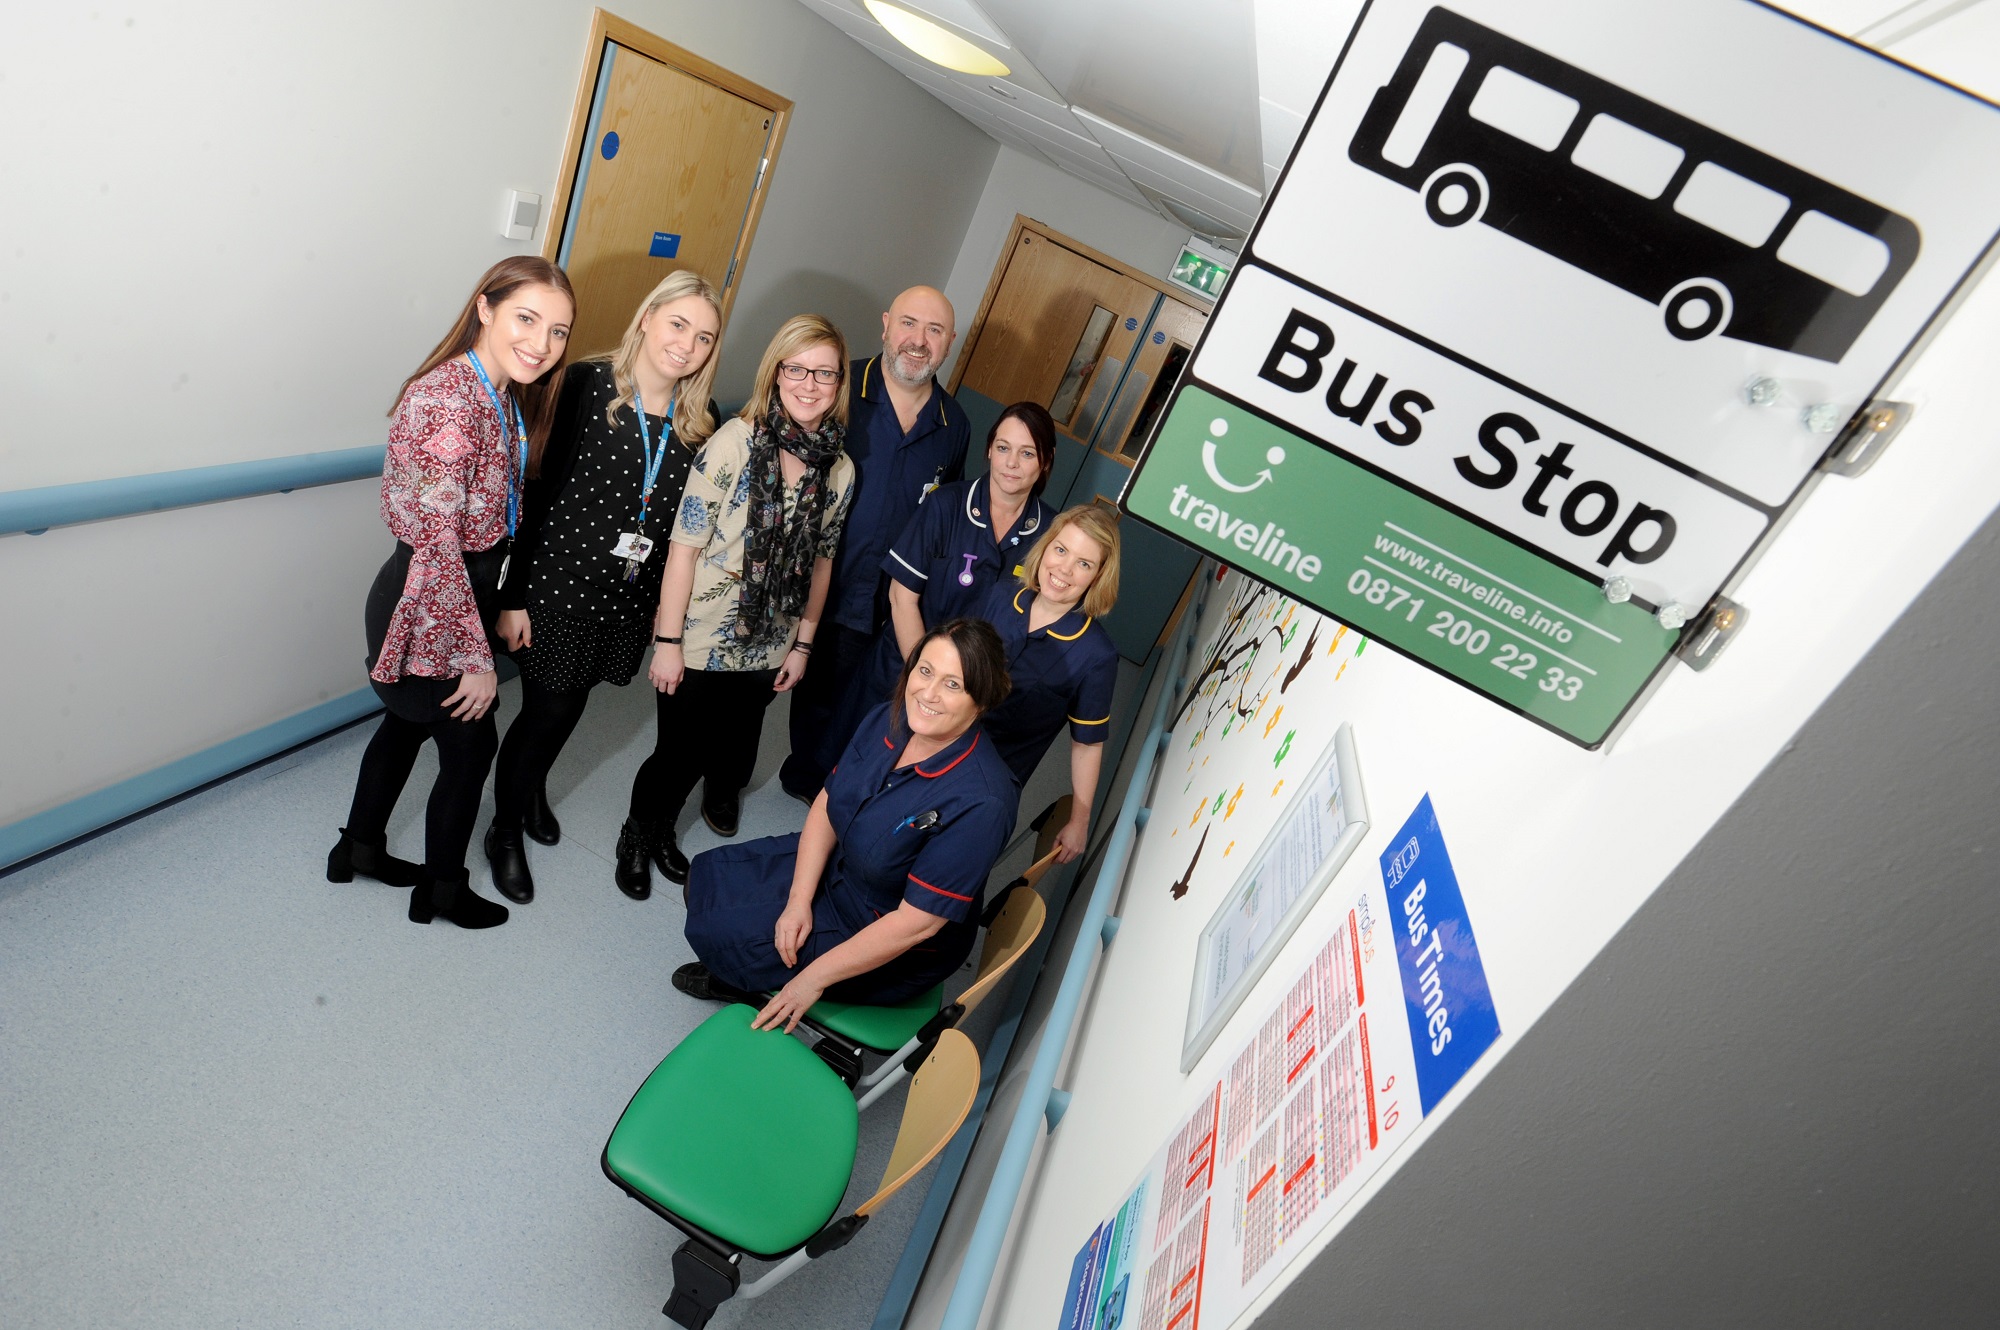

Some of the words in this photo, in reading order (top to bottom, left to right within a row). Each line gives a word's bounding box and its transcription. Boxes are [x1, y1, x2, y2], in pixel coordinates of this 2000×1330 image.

[1257, 307, 1435, 447] Bus
[1453, 412, 1677, 568] Stop
[1168, 484, 1322, 582] traveline
[1347, 569, 1425, 622] 0871
[1427, 610, 1491, 655] 200
[1490, 643, 1538, 680] 22
[1538, 666, 1584, 702] 33
[1374, 534, 1573, 644] www.traveline.info
[1403, 878, 1428, 947] Bus
[1416, 928, 1452, 1056] Times
[1381, 1075, 1395, 1092] 9
[1383, 1100, 1399, 1131] 10
[1071, 1258, 1091, 1329] Stagecoach
